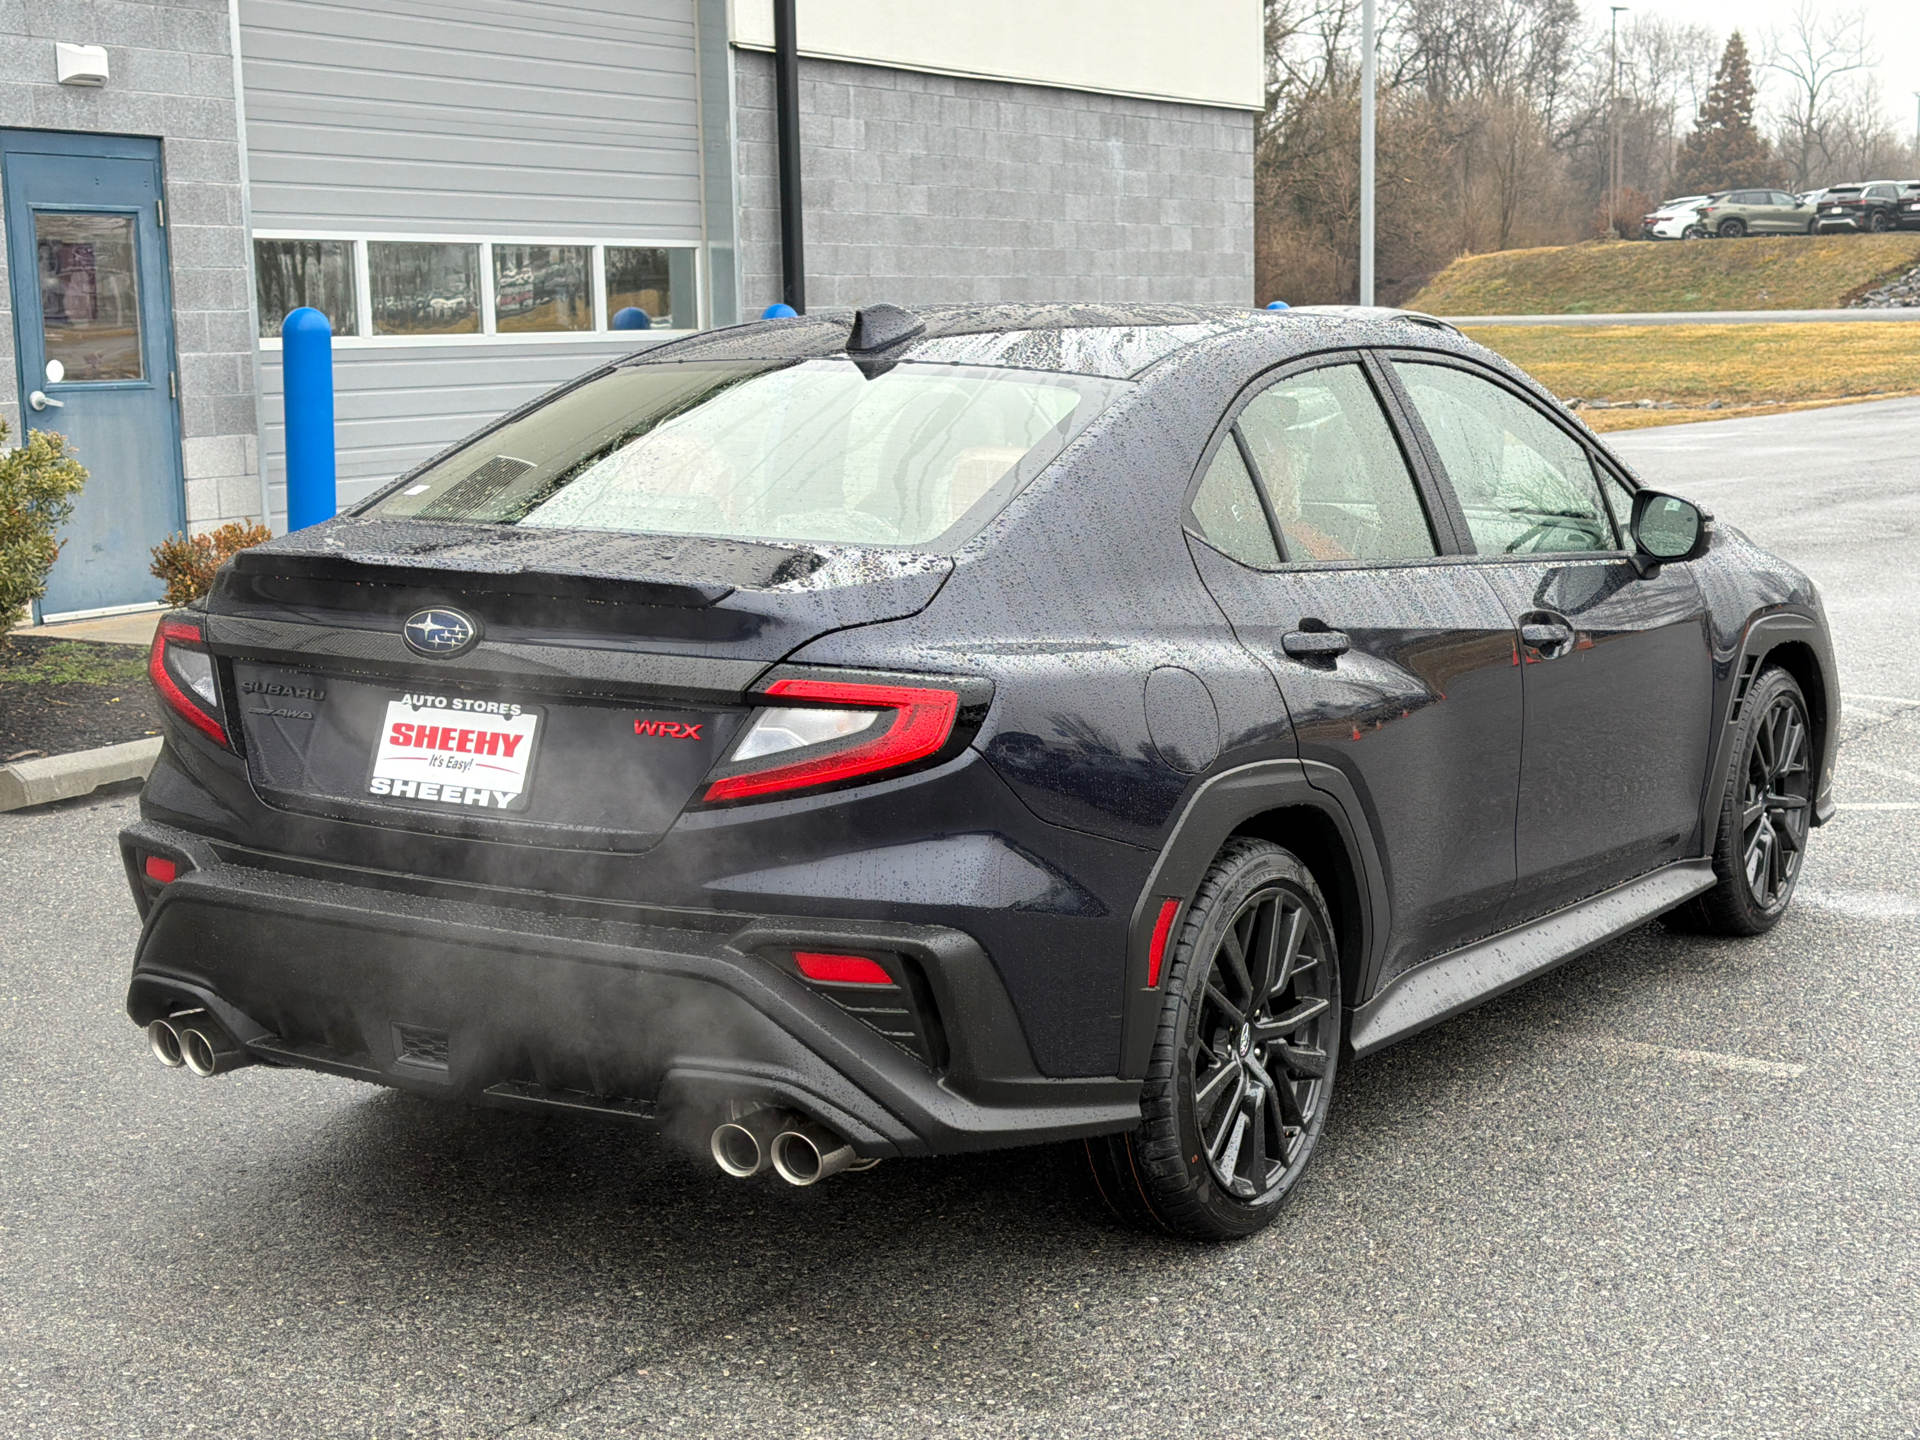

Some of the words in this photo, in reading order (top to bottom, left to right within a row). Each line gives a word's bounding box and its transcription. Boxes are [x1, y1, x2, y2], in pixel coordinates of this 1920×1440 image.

[242, 681, 325, 700] SUBARU
[401, 694, 447, 708] AUTO
[452, 698, 521, 716] STORES
[389, 722, 524, 758] SHEEHY
[634, 719, 703, 740] WRX
[429, 754, 445, 768] It's
[446, 756, 474, 774] Easy!
[369, 777, 518, 809] SHEEHY
